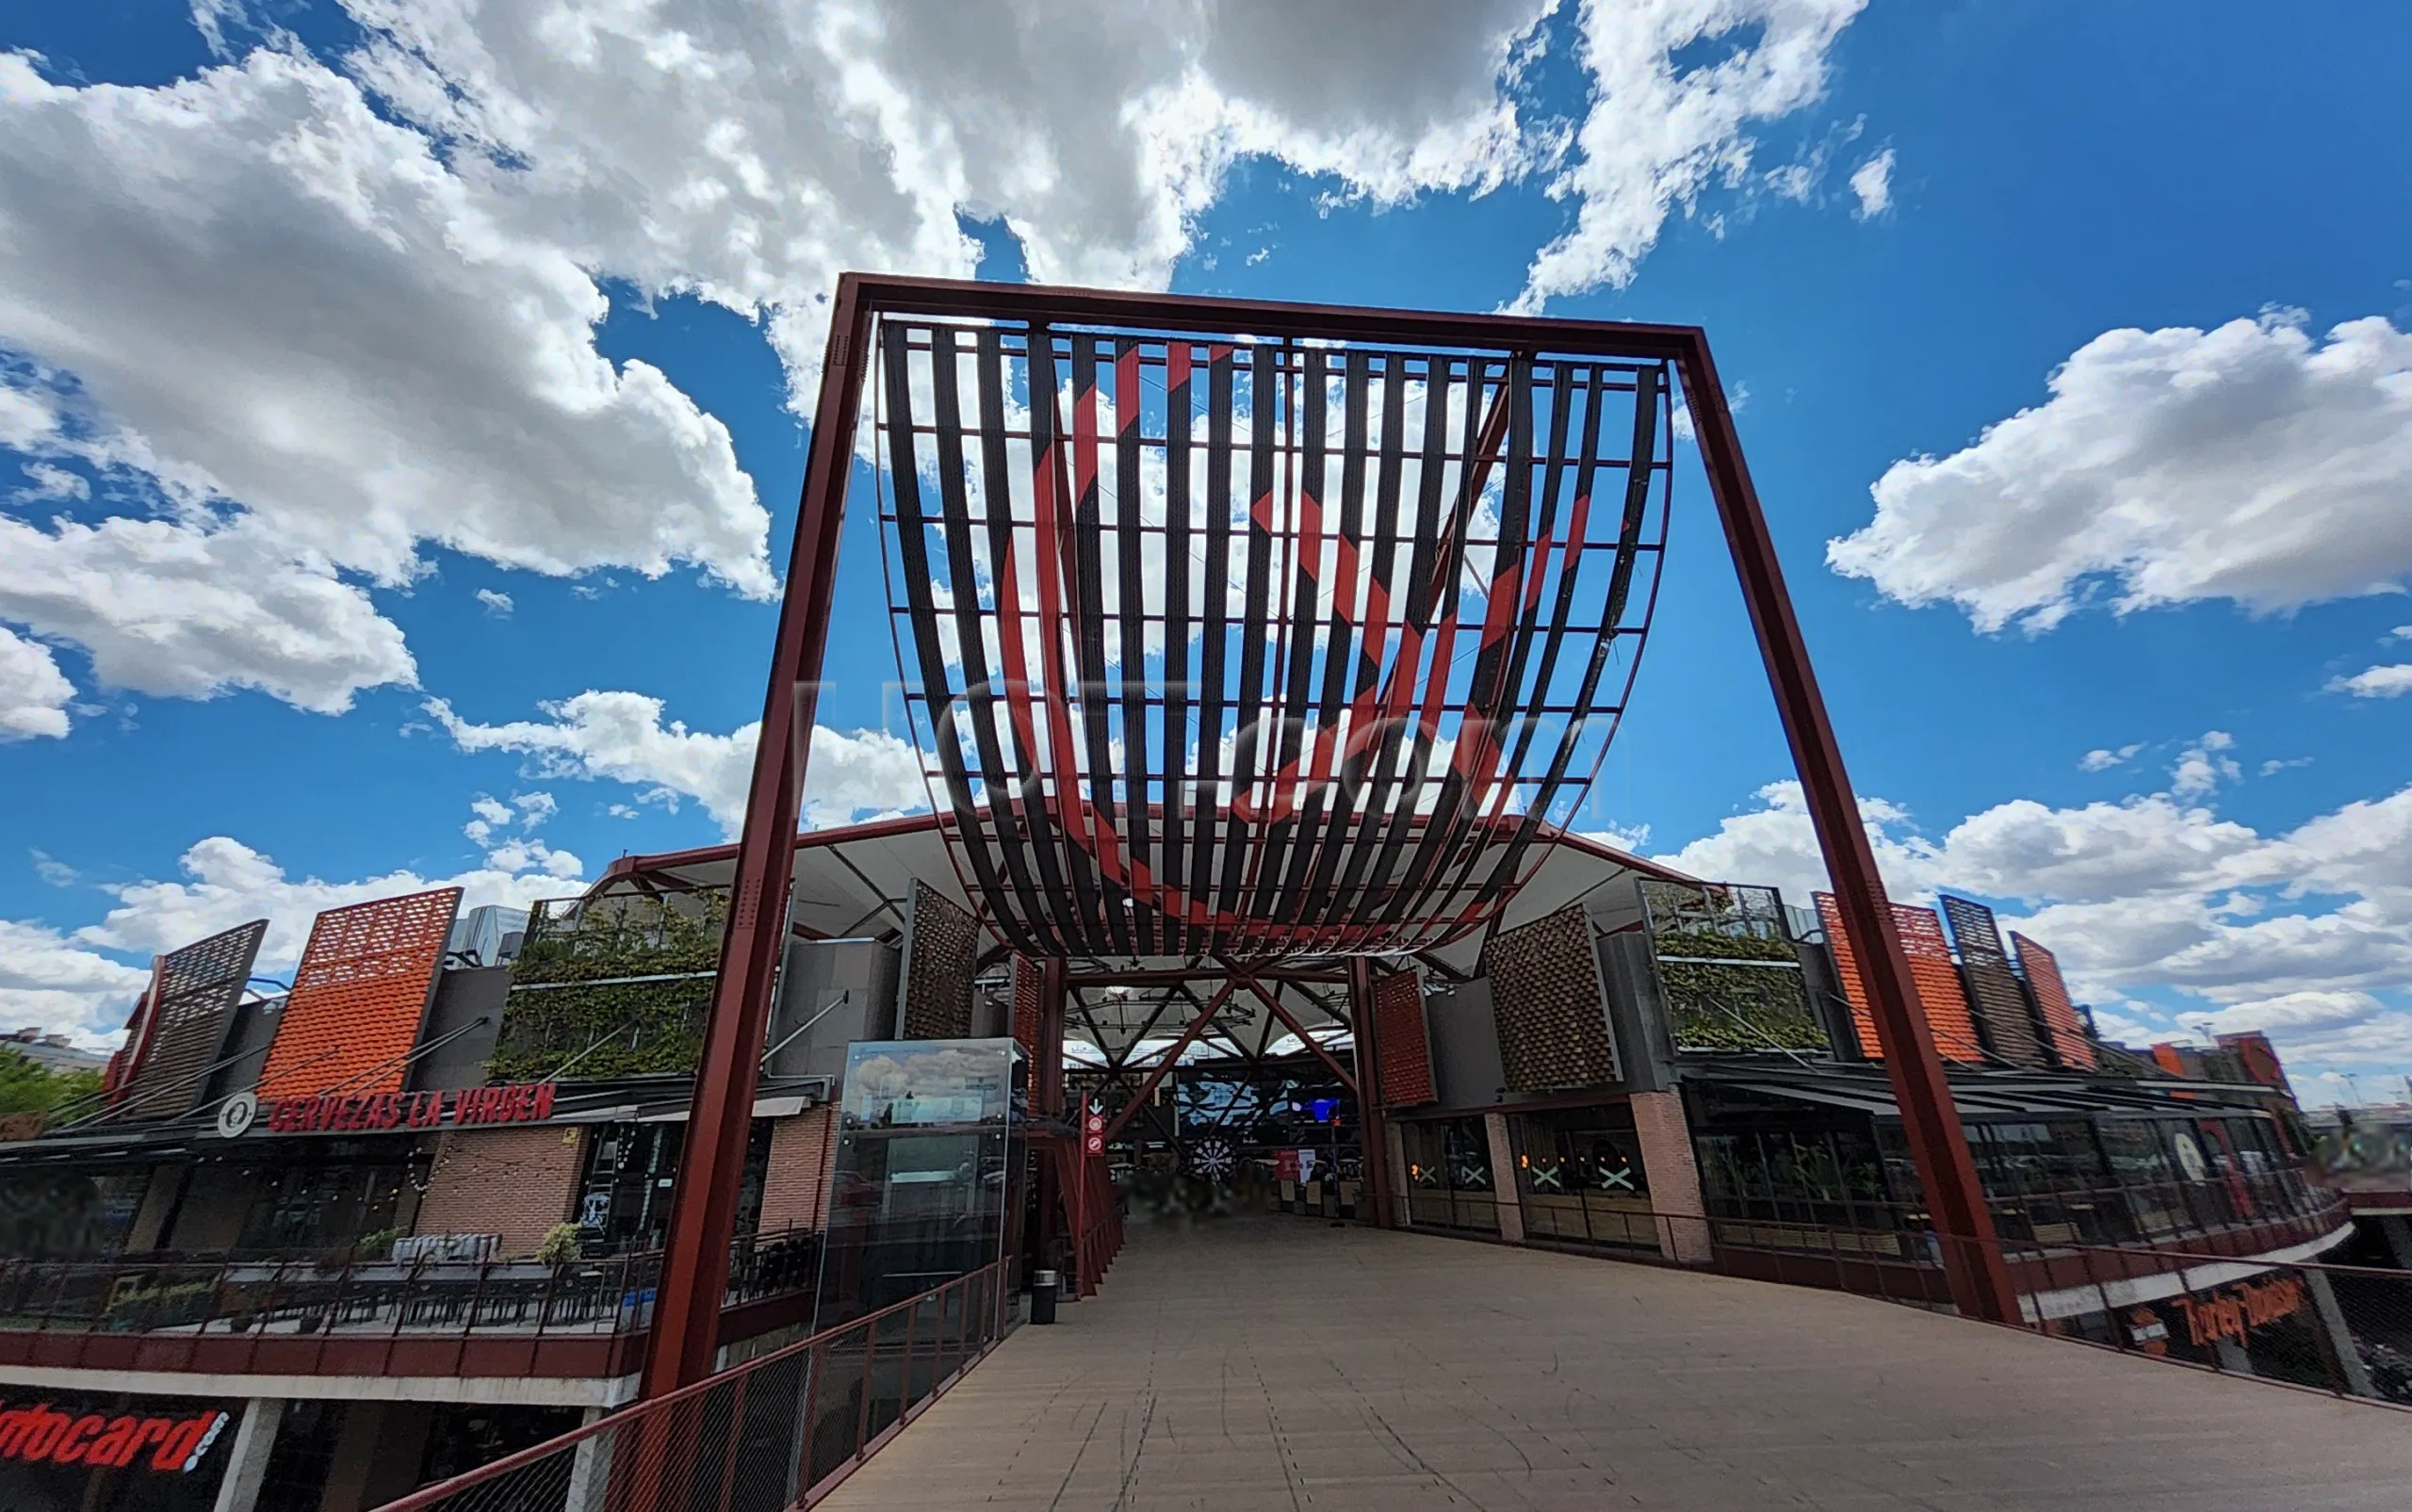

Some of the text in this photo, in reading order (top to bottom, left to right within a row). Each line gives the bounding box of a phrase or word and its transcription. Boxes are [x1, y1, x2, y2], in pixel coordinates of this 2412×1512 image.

[269, 1093, 404, 1131] CERVEZAS
[407, 1090, 444, 1128] LA
[453, 1082, 557, 1126] VIRGEN
